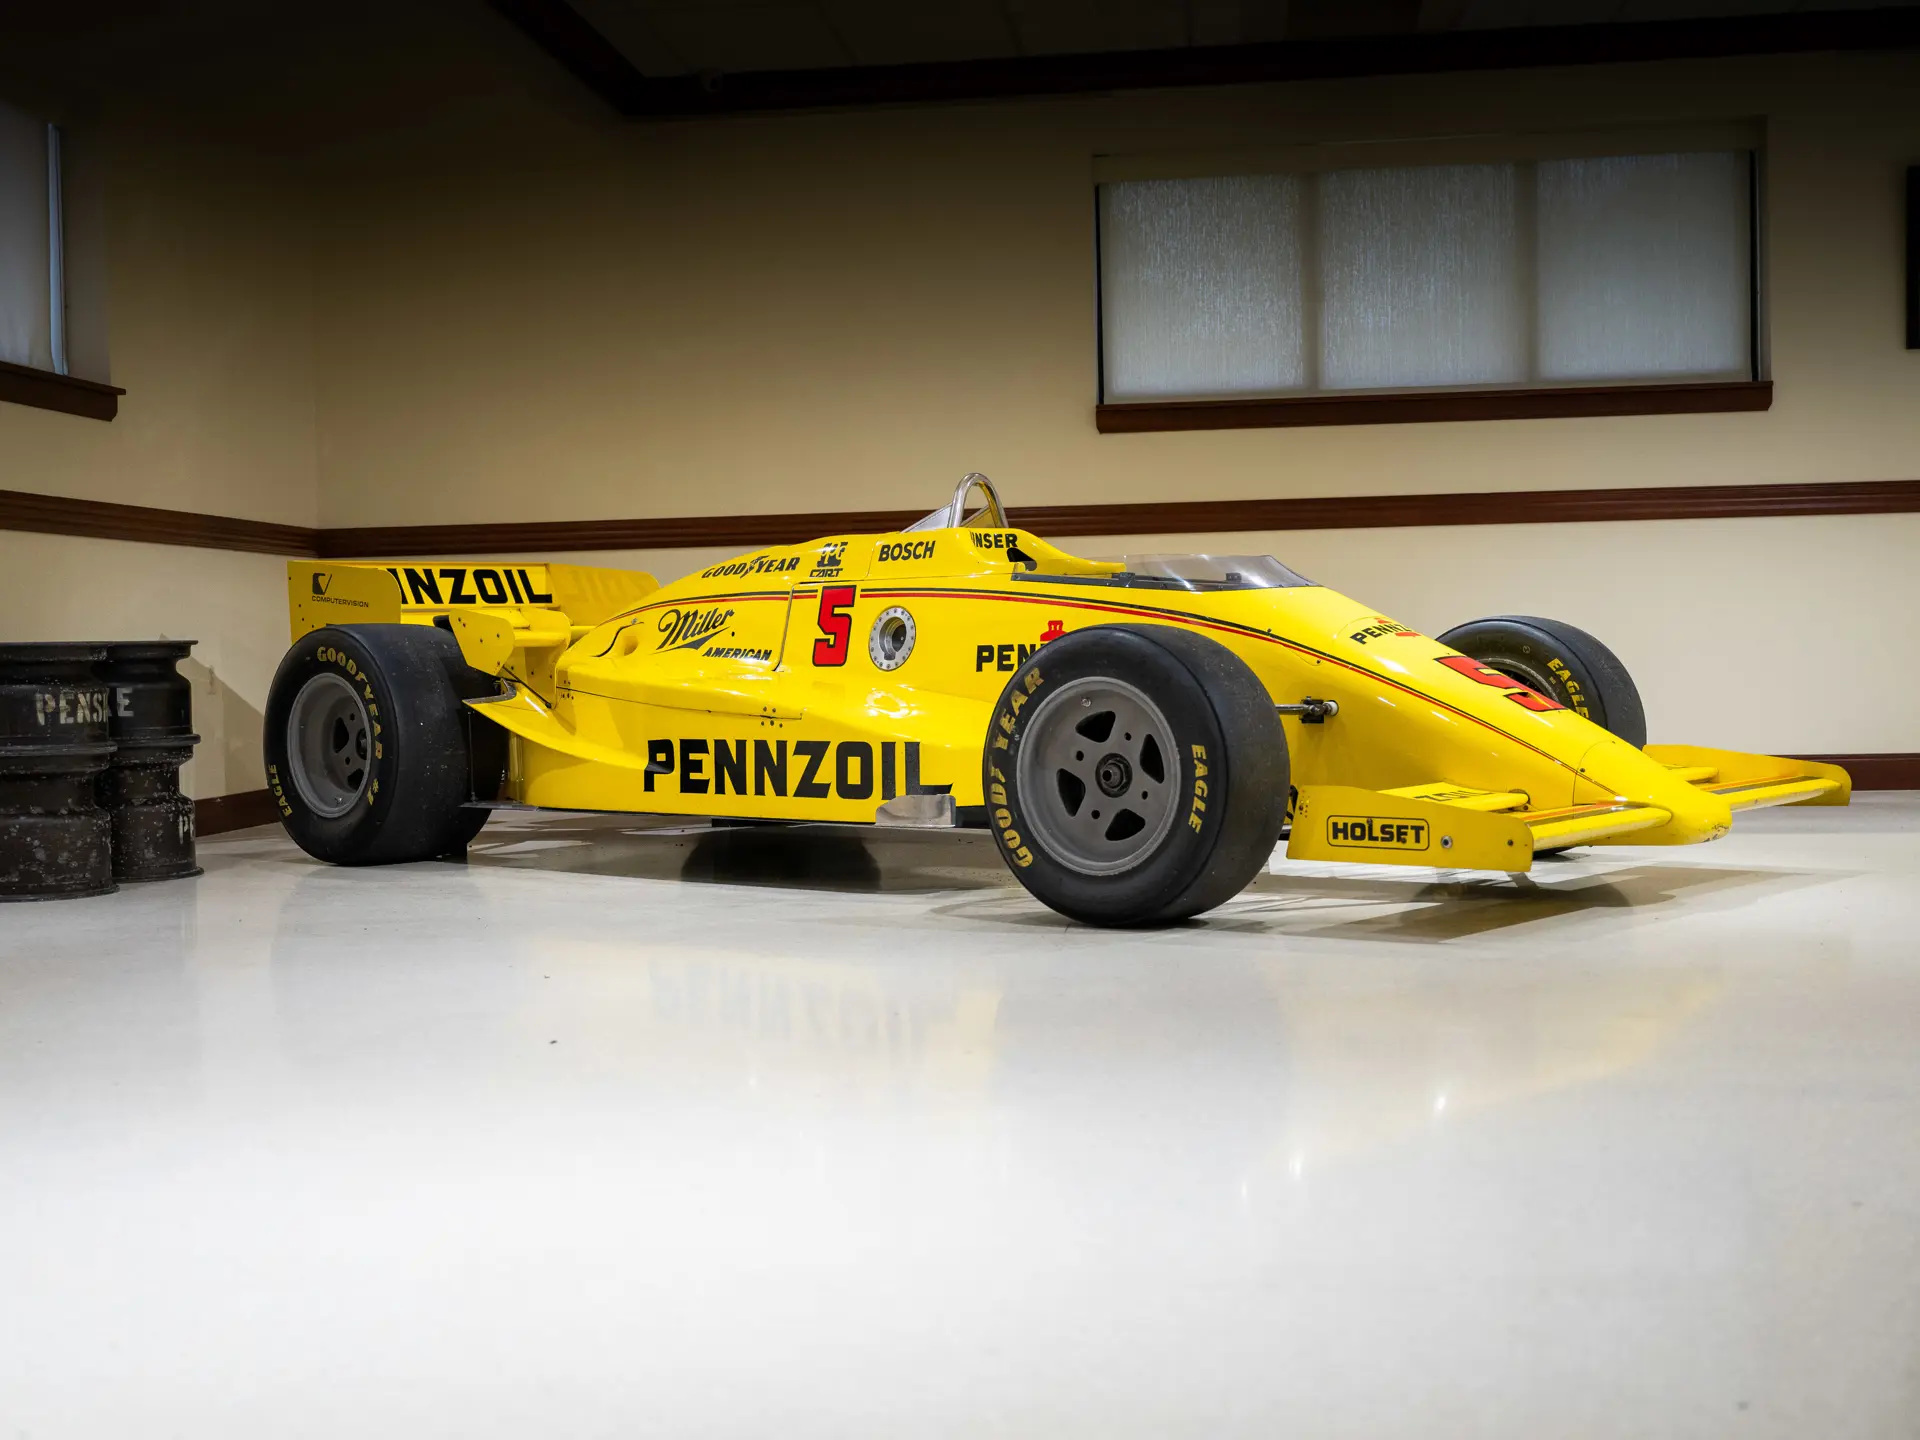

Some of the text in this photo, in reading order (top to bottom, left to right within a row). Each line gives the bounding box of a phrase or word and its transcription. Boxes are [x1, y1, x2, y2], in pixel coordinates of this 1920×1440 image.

[702, 555, 800, 579] GOODYEAR
[879, 540, 936, 562] BOSCH
[809, 568, 843, 578] CART
[311, 595, 369, 608] COMPUTERVISION
[656, 607, 735, 651] Miller
[812, 585, 856, 667] 5
[702, 646, 773, 661] AMERICAN
[976, 643, 1047, 672] PEN
[1432, 655, 1569, 713] 5
[1547, 658, 1589, 719] EAGLE
[643, 737, 953, 800] PENNZOIL
[267, 763, 294, 818] EAGLE
[1188, 743, 1210, 835] EAGLE
[1331, 822, 1426, 845] HOLSET
